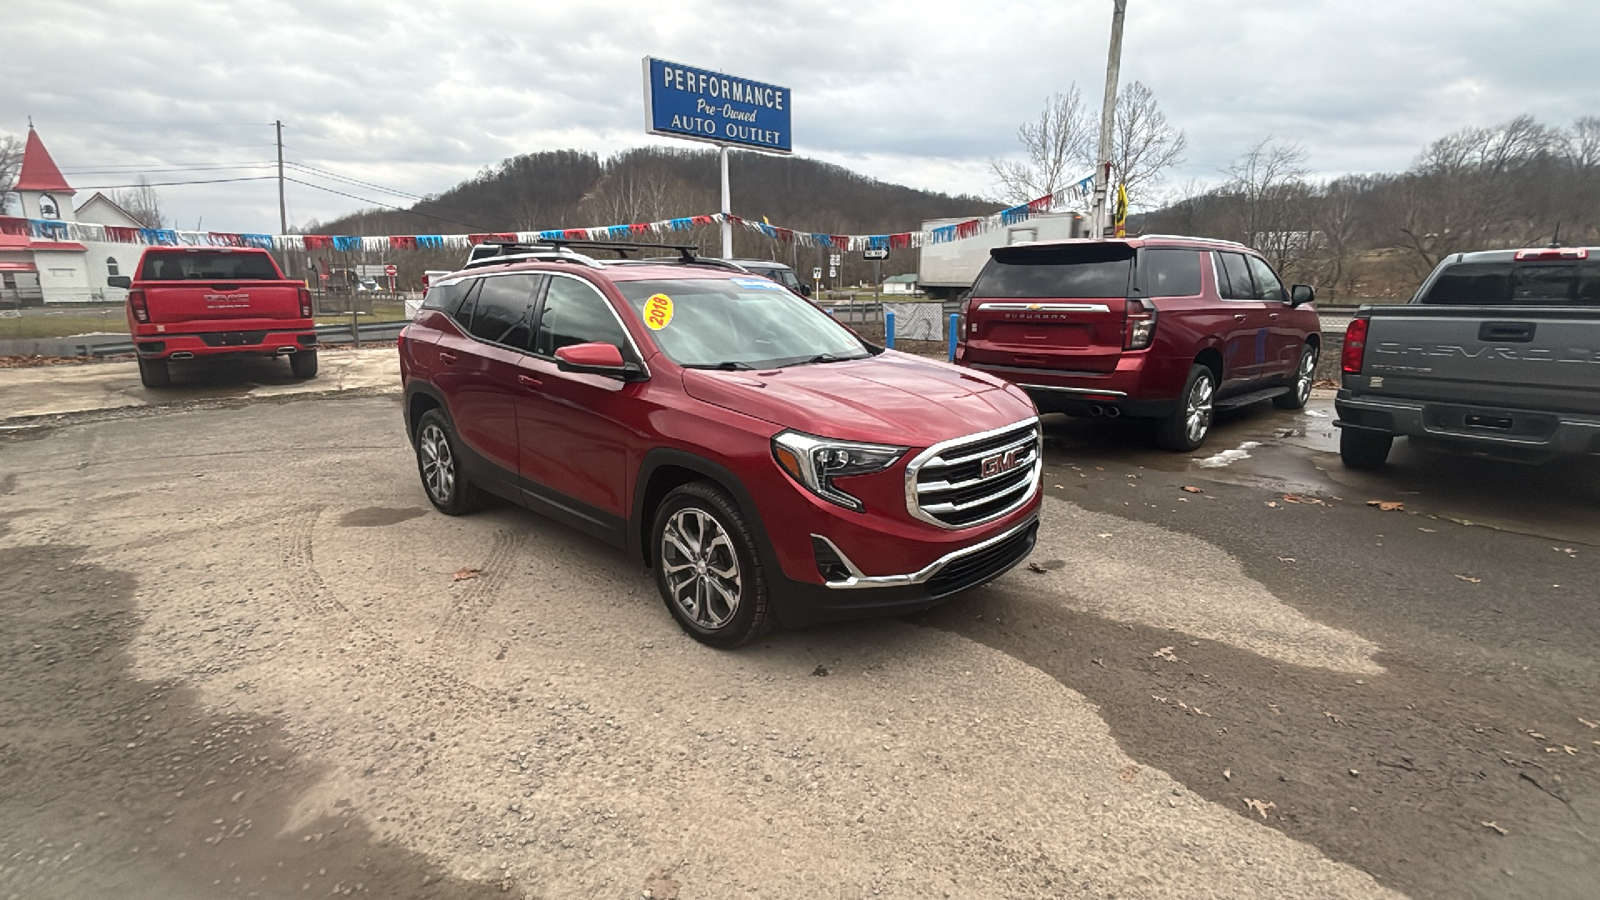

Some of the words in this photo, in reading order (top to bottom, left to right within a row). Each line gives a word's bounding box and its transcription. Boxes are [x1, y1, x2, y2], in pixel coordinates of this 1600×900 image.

[664, 66, 783, 111] PERFORMANCE
[697, 98, 757, 123] Pre-Owned
[671, 114, 716, 134] AUTO
[726, 122, 781, 145] OUTLET
[649, 296, 669, 326] 2018
[982, 446, 1024, 478] GMC
